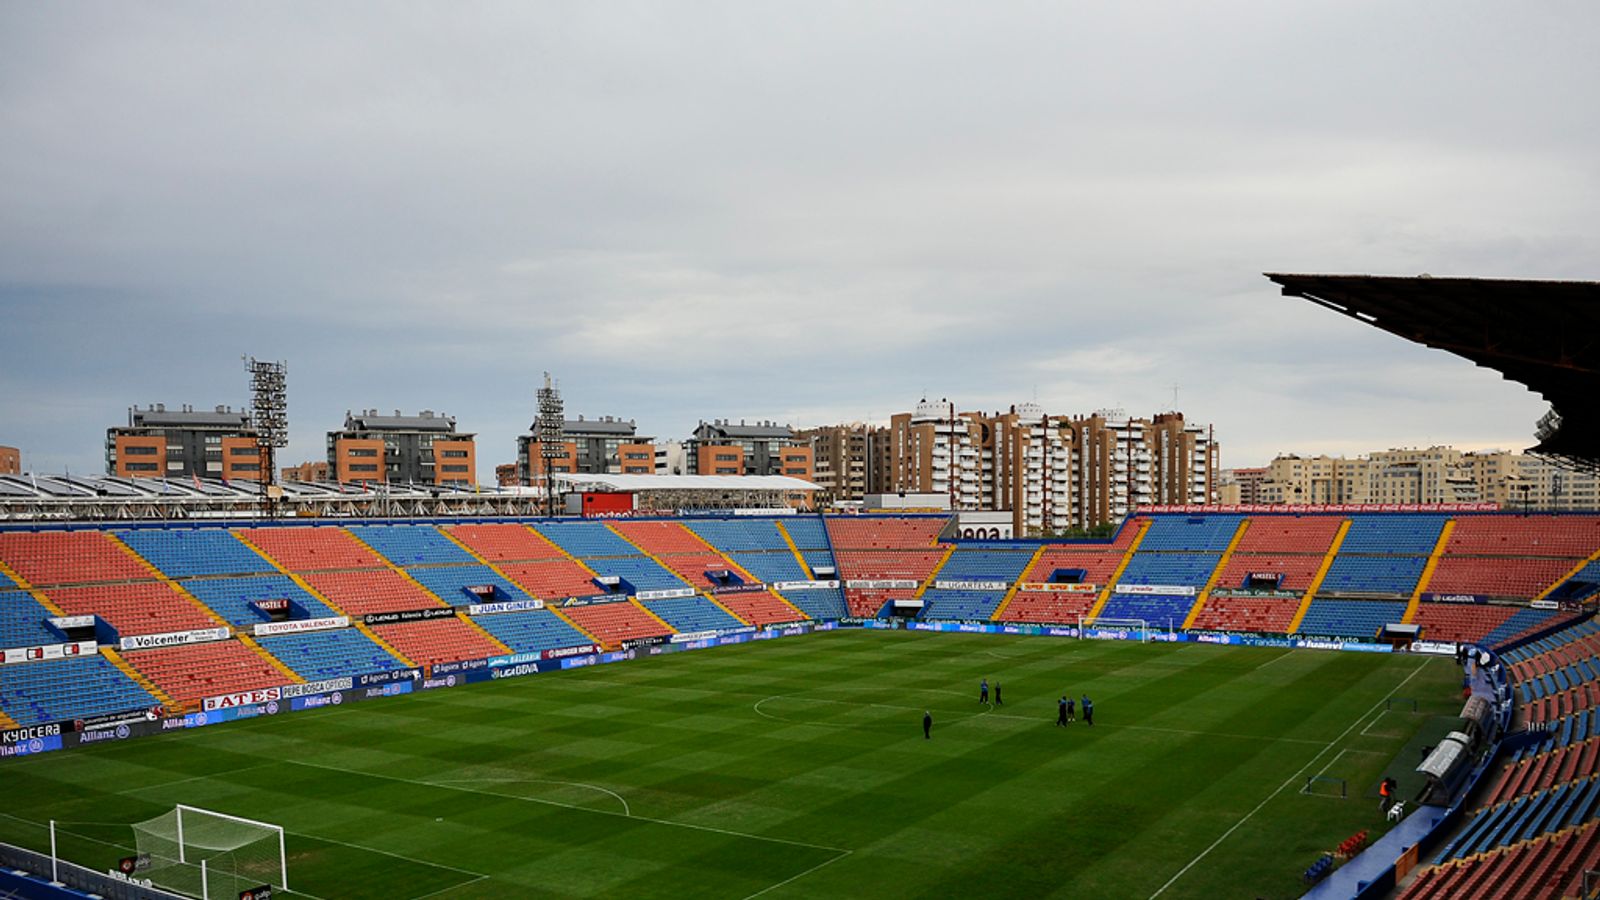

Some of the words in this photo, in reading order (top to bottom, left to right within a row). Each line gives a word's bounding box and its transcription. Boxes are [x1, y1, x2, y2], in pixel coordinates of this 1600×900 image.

[479, 604, 504, 614] JUAN
[268, 623, 298, 632] TOYOTA
[300, 620, 336, 629] VALENCIA
[136, 634, 189, 647] Volcenter
[284, 685, 300, 696] PEPE
[162, 717, 194, 730] Allianz
[3, 724, 61, 744] KYOCERA
[79, 730, 115, 743] Allianz
[0, 744, 28, 756] lianz
